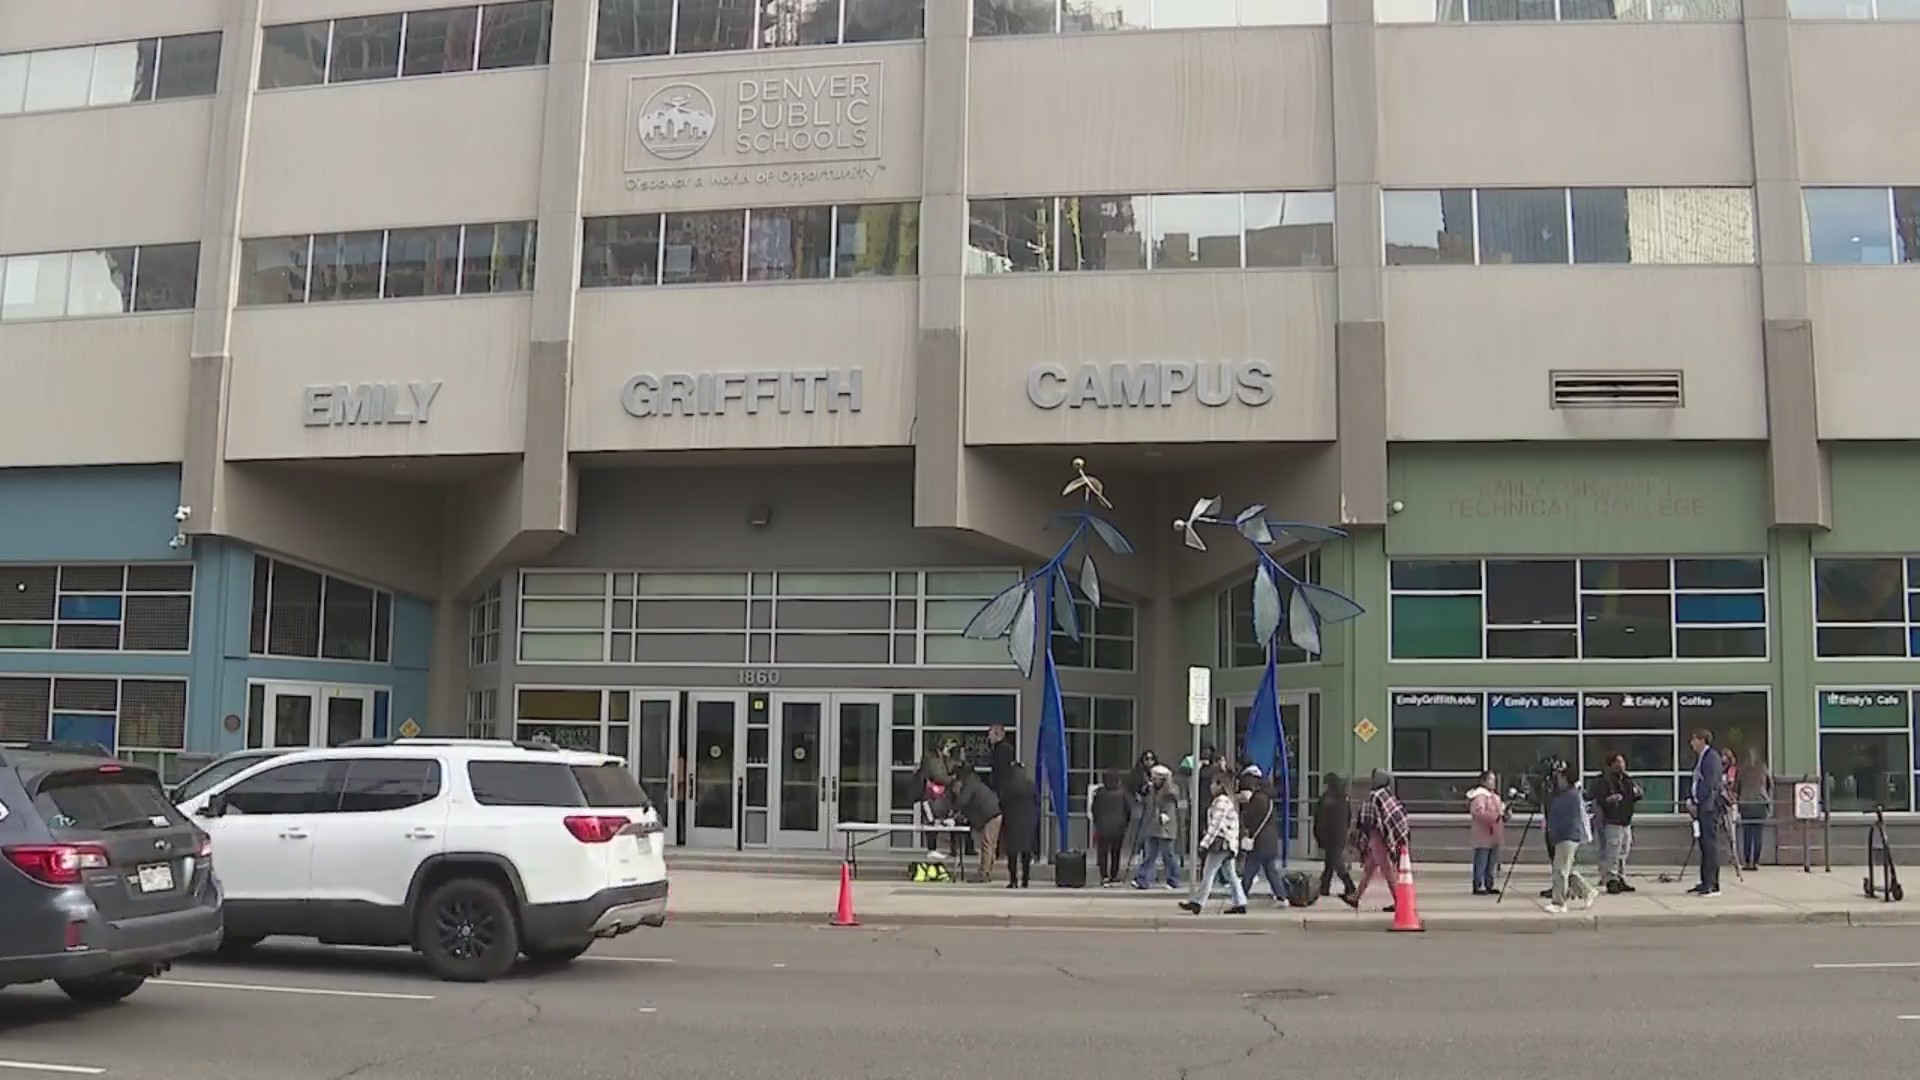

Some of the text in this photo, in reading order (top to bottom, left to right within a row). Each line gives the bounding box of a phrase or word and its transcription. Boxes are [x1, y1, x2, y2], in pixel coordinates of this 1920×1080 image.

[738, 73, 870, 102] DENVER
[737, 99, 870, 130] PUBLIC
[736, 128, 868, 153] SCHOOLS
[626, 176, 690, 191] Discover
[695, 178, 704, 188] a
[756, 171, 774, 184] of
[304, 361, 1275, 427] EMILY GRIFFITH CAMPUS
[1448, 498, 1576, 518] TECHNICAL
[739, 670, 780, 685] 1860
[1396, 694, 1476, 707] EmilyGriffith.edu
[1504, 696, 1610, 709] Emily's Barber Shop
[1636, 695, 1713, 709] Emily's Coffee
[1840, 695, 1900, 707] Emily's Cafe
